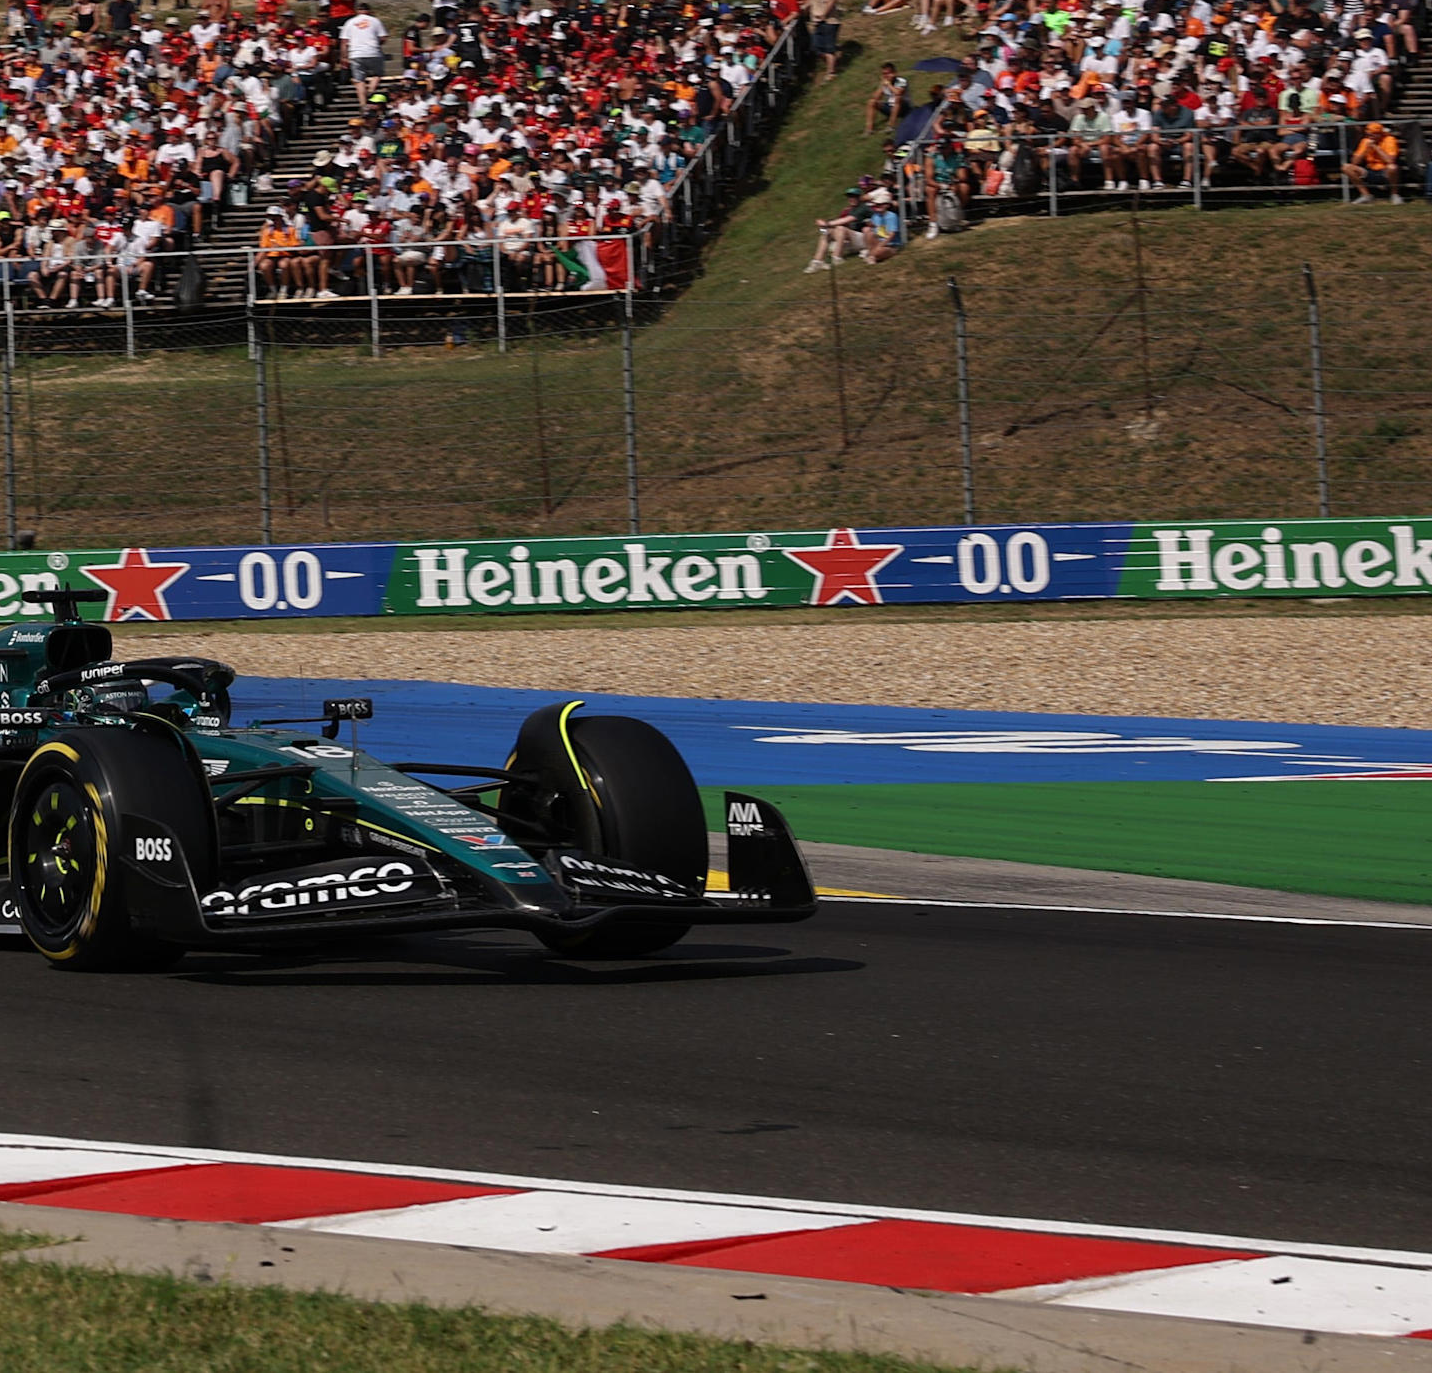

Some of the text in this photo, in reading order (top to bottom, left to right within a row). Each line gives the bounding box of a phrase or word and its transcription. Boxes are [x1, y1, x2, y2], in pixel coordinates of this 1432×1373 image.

[240, 551, 322, 609] 0.0
[416, 532, 1049, 606] Heineken 0.0
[1153, 525, 1432, 590] Heinek
[0, 712, 43, 725] BOSS
[277, 745, 354, 759] 18
[136, 837, 172, 861] BOSS
[200, 862, 414, 916] aramco
